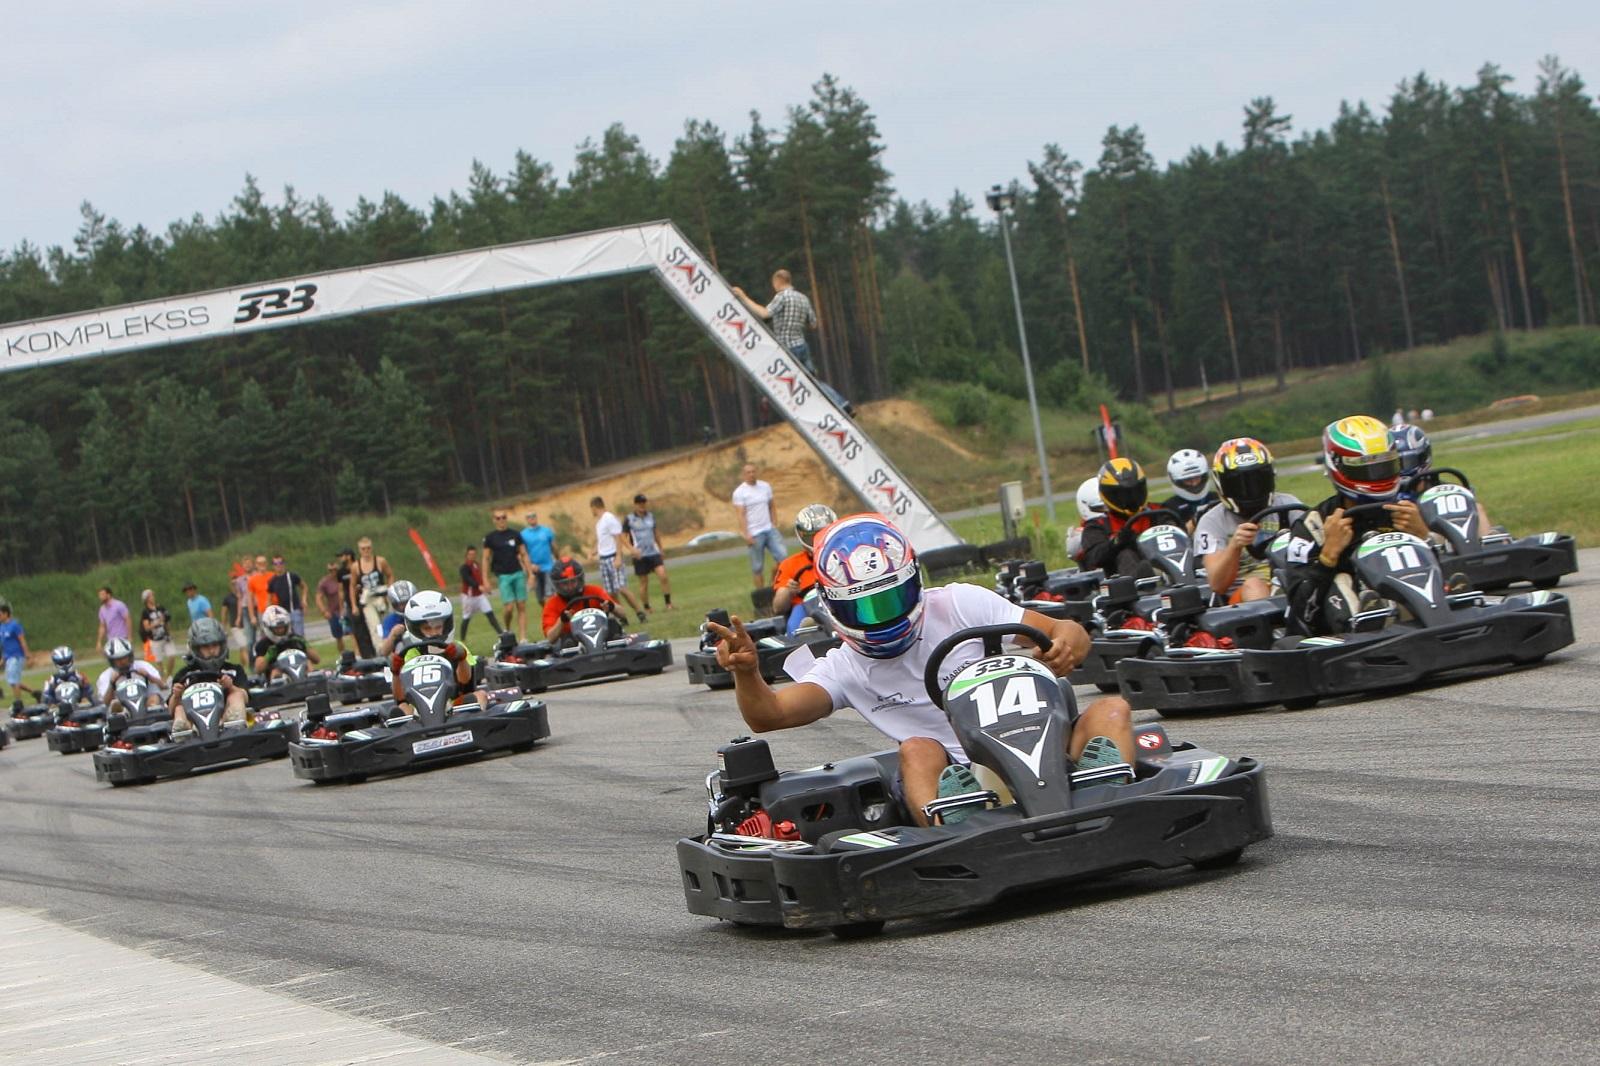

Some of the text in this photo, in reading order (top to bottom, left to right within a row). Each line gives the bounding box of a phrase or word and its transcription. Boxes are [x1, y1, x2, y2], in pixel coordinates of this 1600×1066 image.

[6, 284, 318, 356] KOMPLEKSS 333
[1433, 494, 1467, 515] 10
[1157, 534, 1177, 551] 5
[1200, 533, 1209, 550] 3
[1381, 545, 1421, 571] 11
[582, 615, 597, 630] 2
[411, 665, 442, 686] 15
[974, 658, 1017, 677] 333
[190, 690, 216, 709] 13
[969, 676, 1048, 727] 14
